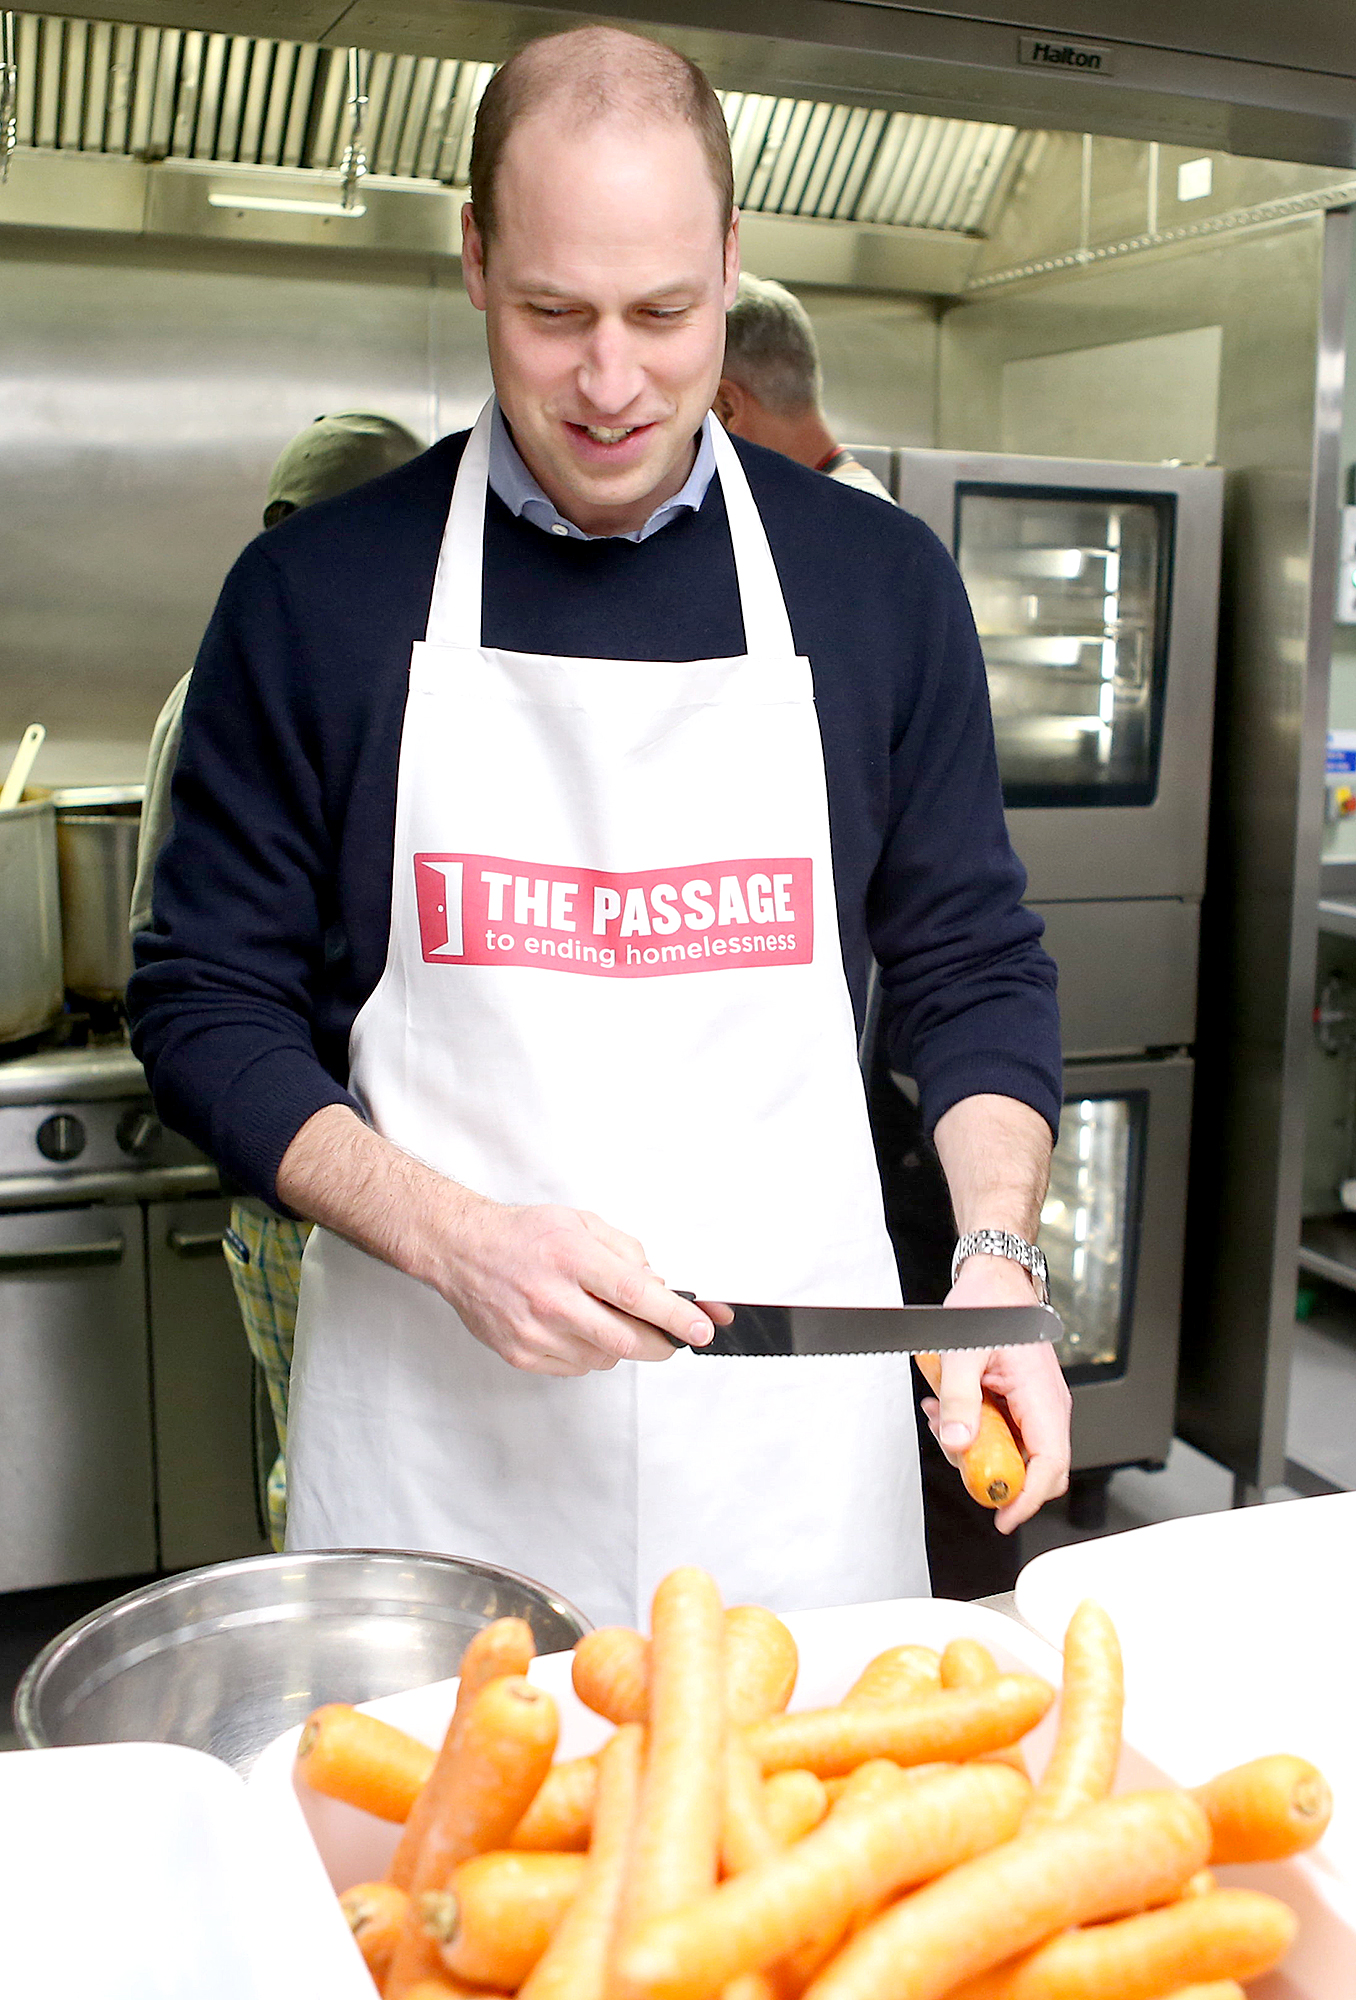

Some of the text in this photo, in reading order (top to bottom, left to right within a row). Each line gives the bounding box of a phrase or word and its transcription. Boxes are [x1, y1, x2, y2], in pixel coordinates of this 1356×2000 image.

[1033, 42, 1101, 69] Halton
[480, 871, 796, 938] THE PASSAGE
[486, 930, 796, 968] to ending homelessness
